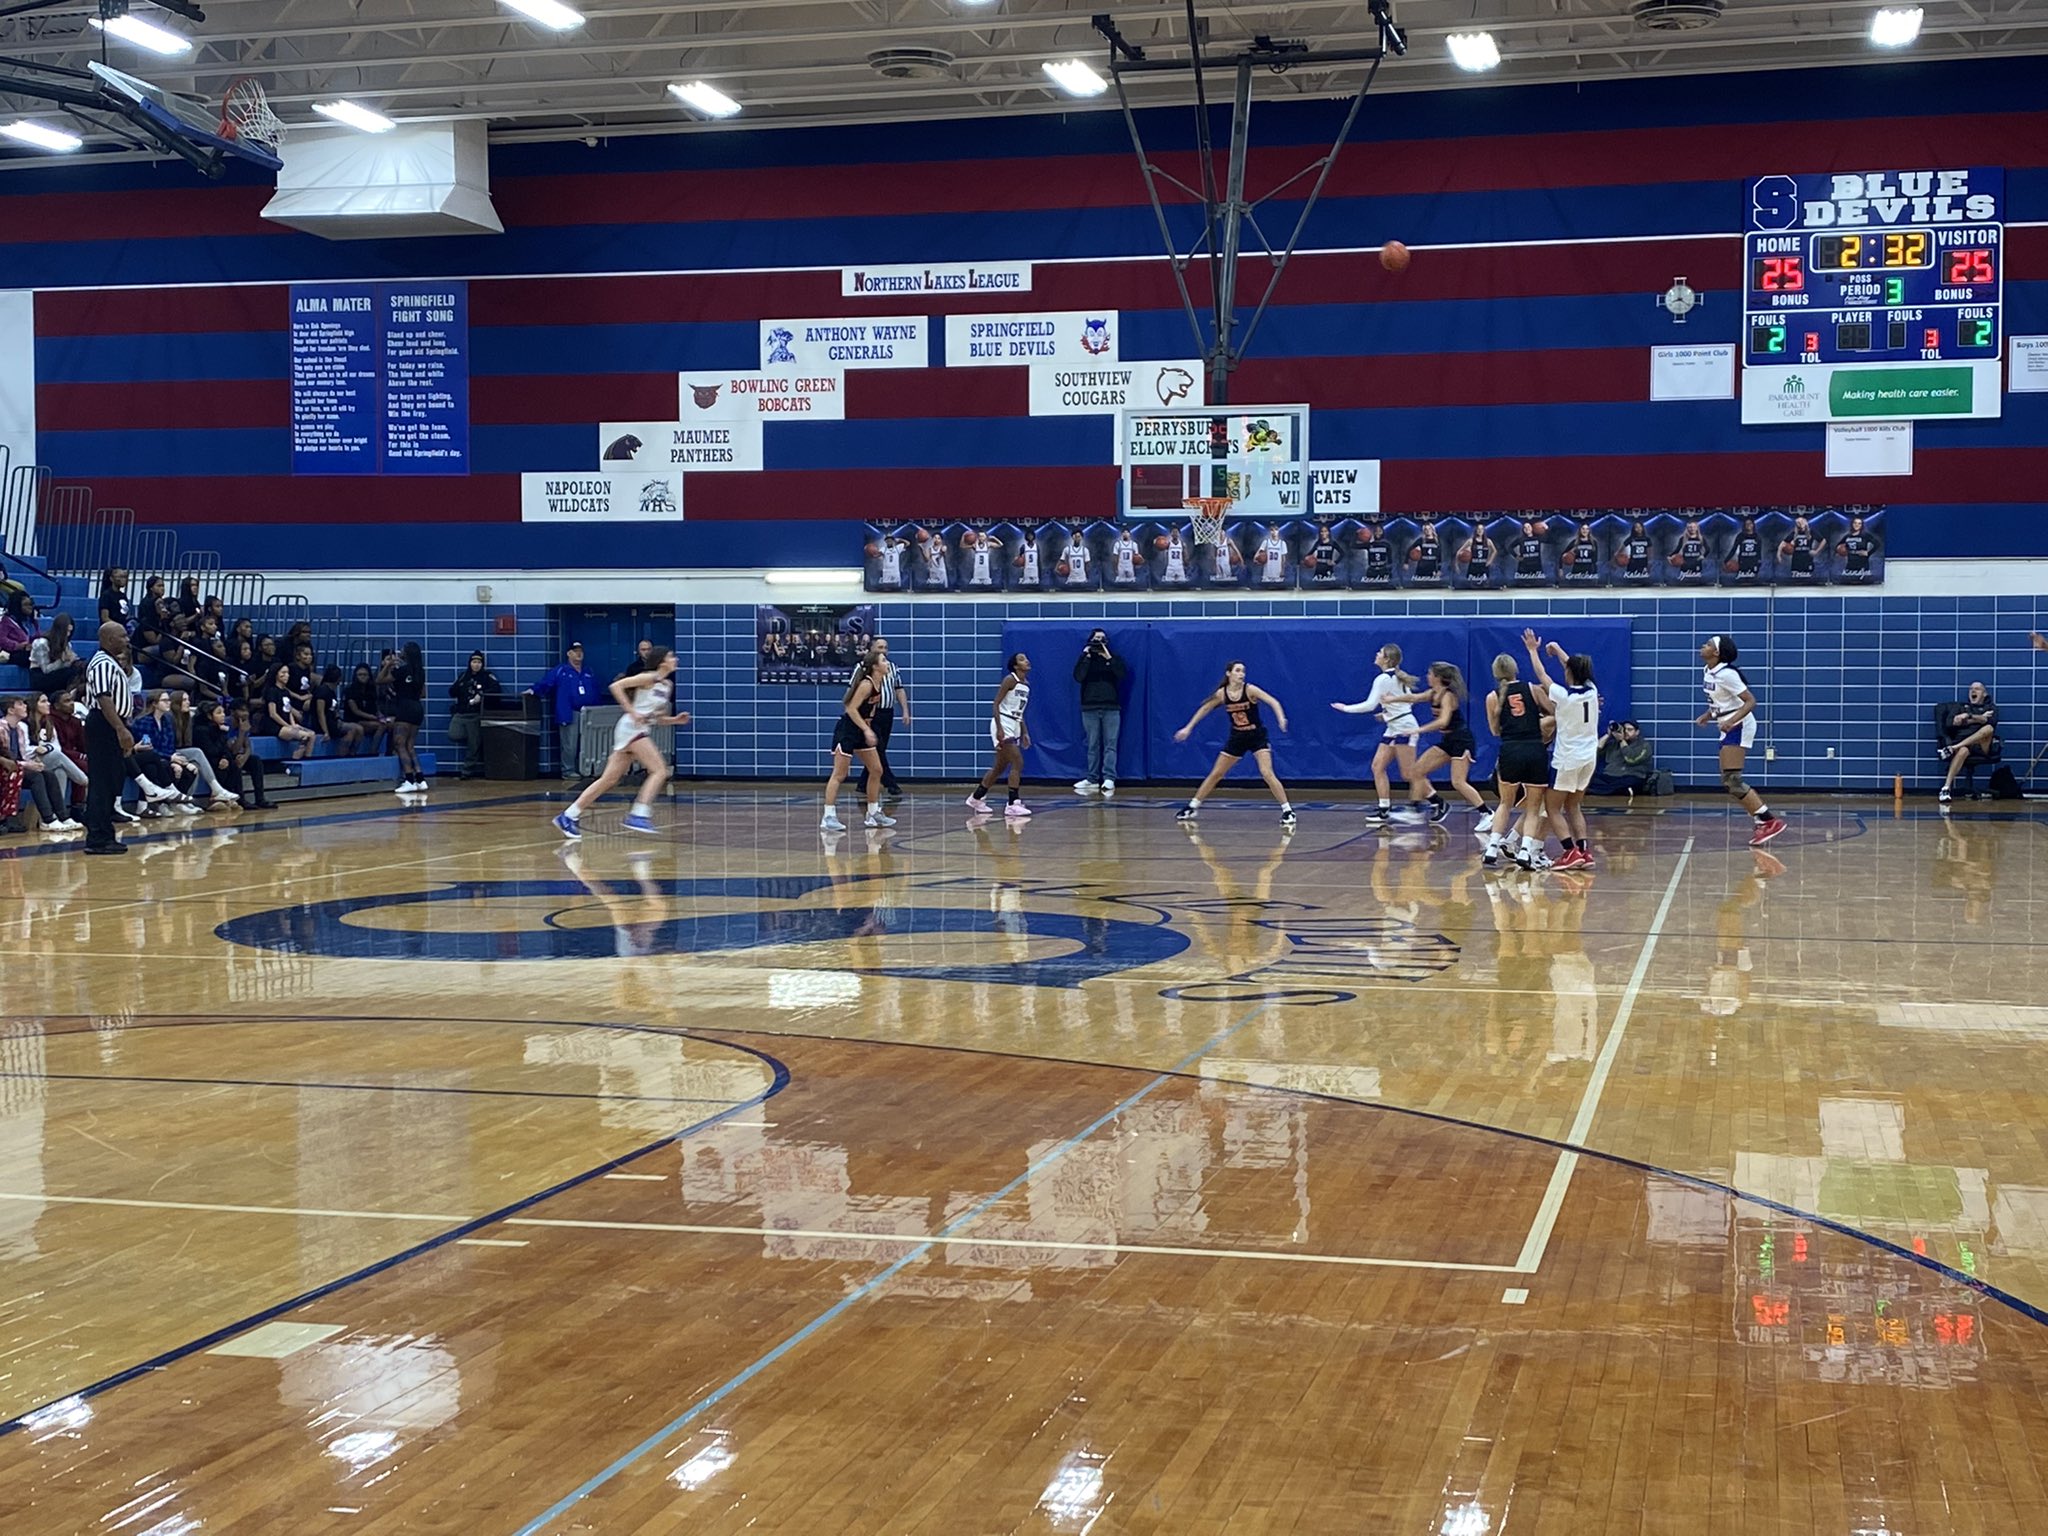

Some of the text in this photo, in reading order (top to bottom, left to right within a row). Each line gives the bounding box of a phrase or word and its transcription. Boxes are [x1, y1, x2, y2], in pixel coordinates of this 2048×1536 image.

[1831, 170, 1968, 200] BLUE
[1803, 195, 1995, 226] DEVILS
[1757, 237, 1800, 253] HOME
[1938, 229, 1998, 246] VISITOR
[1762, 258, 1802, 290] 25
[1951, 251, 1992, 282] 25
[1849, 274, 1872, 283] POSS
[1840, 284, 1881, 296] PERIOD
[1887, 279, 1902, 303] 3
[1935, 288, 1973, 300] BONUS
[296, 297, 371, 312] ALMA MATER
[390, 294, 456, 308] SPRINGFIELD
[1772, 294, 1809, 306] BONUS
[393, 310, 454, 322] FIGHT SONG
[1752, 314, 1786, 326] FOULS
[1831, 311, 1872, 323] PLAYER
[1887, 310, 1923, 321] FOULS
[1958, 307, 1993, 319] FOULS
[805, 325, 917, 342] ANTHONY WAYNE
[970, 321, 1055, 338] SPRINGFIELD
[1975, 321, 1991, 345] 2
[1769, 327, 1785, 352] 2
[1806, 333, 1819, 351] 3
[1926, 329, 1938, 347] 3
[828, 345, 893, 360] GENERALS
[969, 340, 1056, 357] BLUE DEVILS
[1675, 350, 1692, 358] 1000
[1713, 349, 1728, 357] Club
[1920, 349, 1942, 359] TOL
[1800, 353, 1821, 363] TOL
[731, 377, 836, 394] BOWLING GREEN
[1054, 370, 1132, 388] SOUTHVIEW
[1062, 389, 1126, 406] COUGARS
[1768, 392, 1820, 401] PARAMOUNT
[1842, 388, 1959, 401] Making health care easier.
[758, 397, 811, 412] BOBCATS
[1777, 401, 1810, 409] HEALTH
[1135, 421, 1217, 436] PERRYSBUR
[673, 430, 730, 445] MAUMEE
[1122, 440, 1177, 455] ELLOW
[670, 448, 733, 463] PANTHERS
[1271, 469, 1358, 485] NORHVIEW
[545, 481, 612, 496] NAPOLEON
[548, 497, 610, 513] WILDCATS
[1507, 693, 1526, 717] 5
[1583, 701, 1590, 723] 1
